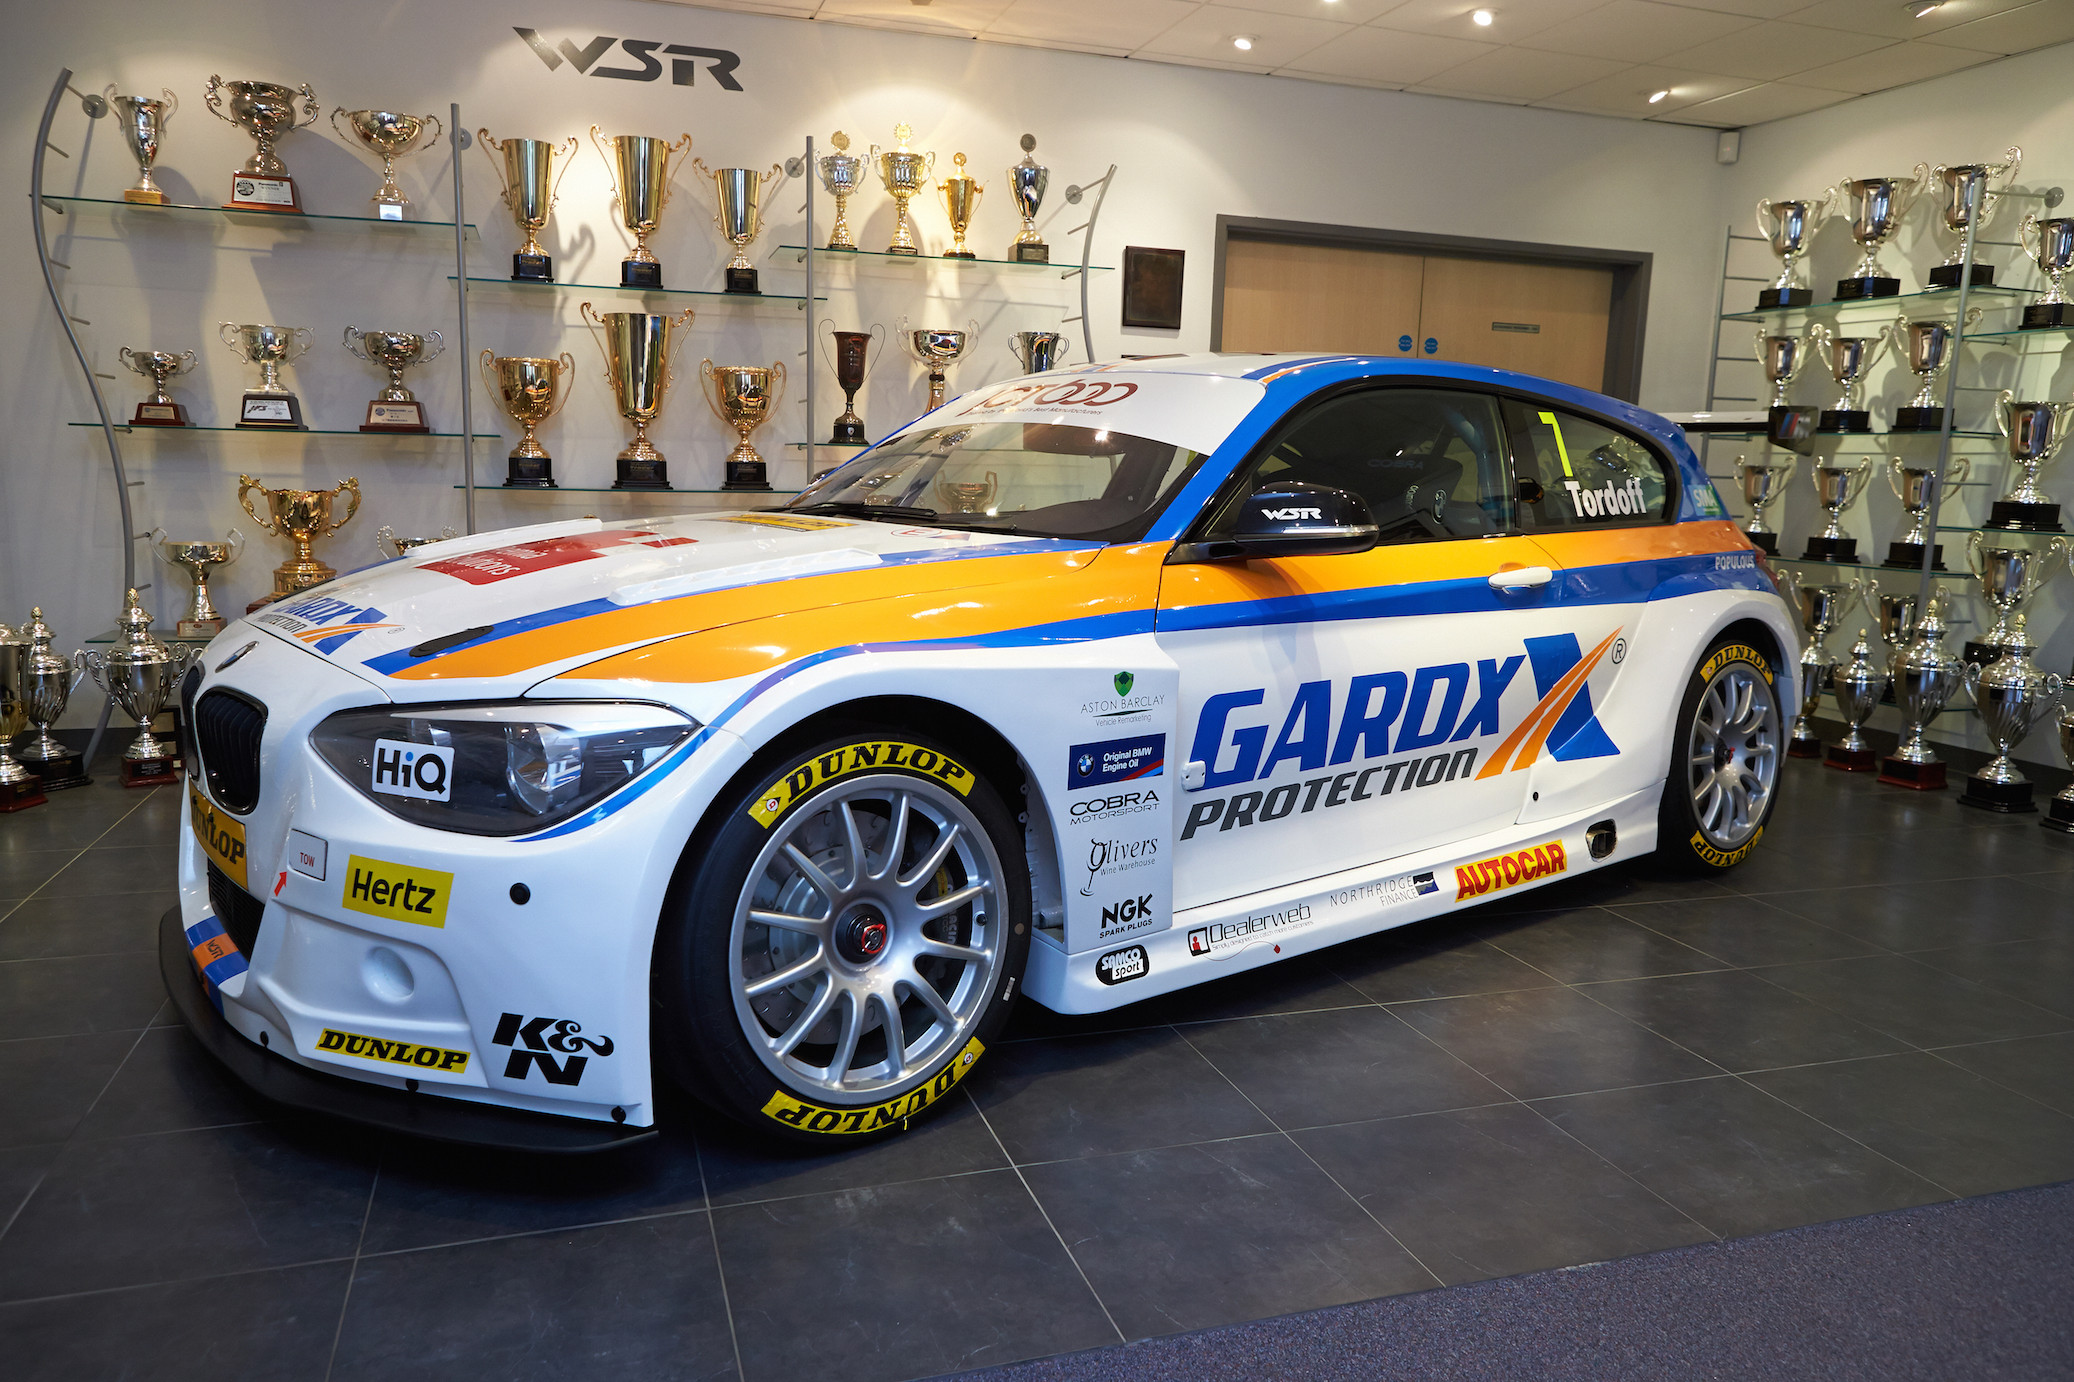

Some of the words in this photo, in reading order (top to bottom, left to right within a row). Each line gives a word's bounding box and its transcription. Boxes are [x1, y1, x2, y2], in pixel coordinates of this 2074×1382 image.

[512, 26, 744, 92] WSR
[1564, 479, 1647, 518] Tordoff
[1261, 507, 1322, 521] WSR
[1715, 555, 1755, 571] POPULOUS
[1714, 647, 1771, 674] DUNLOP
[1081, 699, 1118, 714] ASTON
[1121, 695, 1165, 709] BARCLAY
[1095, 717, 1117, 727] Vehicle
[1118, 714, 1152, 725] Remarketing
[1189, 655, 1527, 792] GARDX
[1102, 762, 1127, 773] Engine
[1128, 759, 1139, 768] Oil
[1103, 750, 1132, 762] Original
[1132, 746, 1153, 758] BMW
[376, 747, 446, 794] HiQ
[786, 743, 966, 803] DUNLOP
[1070, 790, 1160, 816] COBRA
[1179, 747, 1479, 841] PROTECTION
[1069, 803, 1160, 826] MOTORSPORT
[300, 852, 315, 867] TOW
[1089, 838, 1158, 869] Olivers
[1100, 866, 1117, 876] Wine
[1118, 858, 1156, 871] Warehouse
[1456, 843, 1565, 899] AUTOCAR
[352, 868, 436, 914] Hertz
[1330, 875, 1413, 907] NORTHRIDGE
[1380, 889, 1419, 907] FINANCE
[1101, 893, 1153, 929] NGK
[1209, 903, 1311, 943] Dealerweb
[1099, 926, 1126, 939] SPARK
[1127, 919, 1153, 931] PLUGS
[1101, 948, 1141, 971] SAMCO
[1115, 960, 1140, 978] sport
[318, 1030, 468, 1070] DUNLOP
[774, 1062, 958, 1132] DUNLOP
